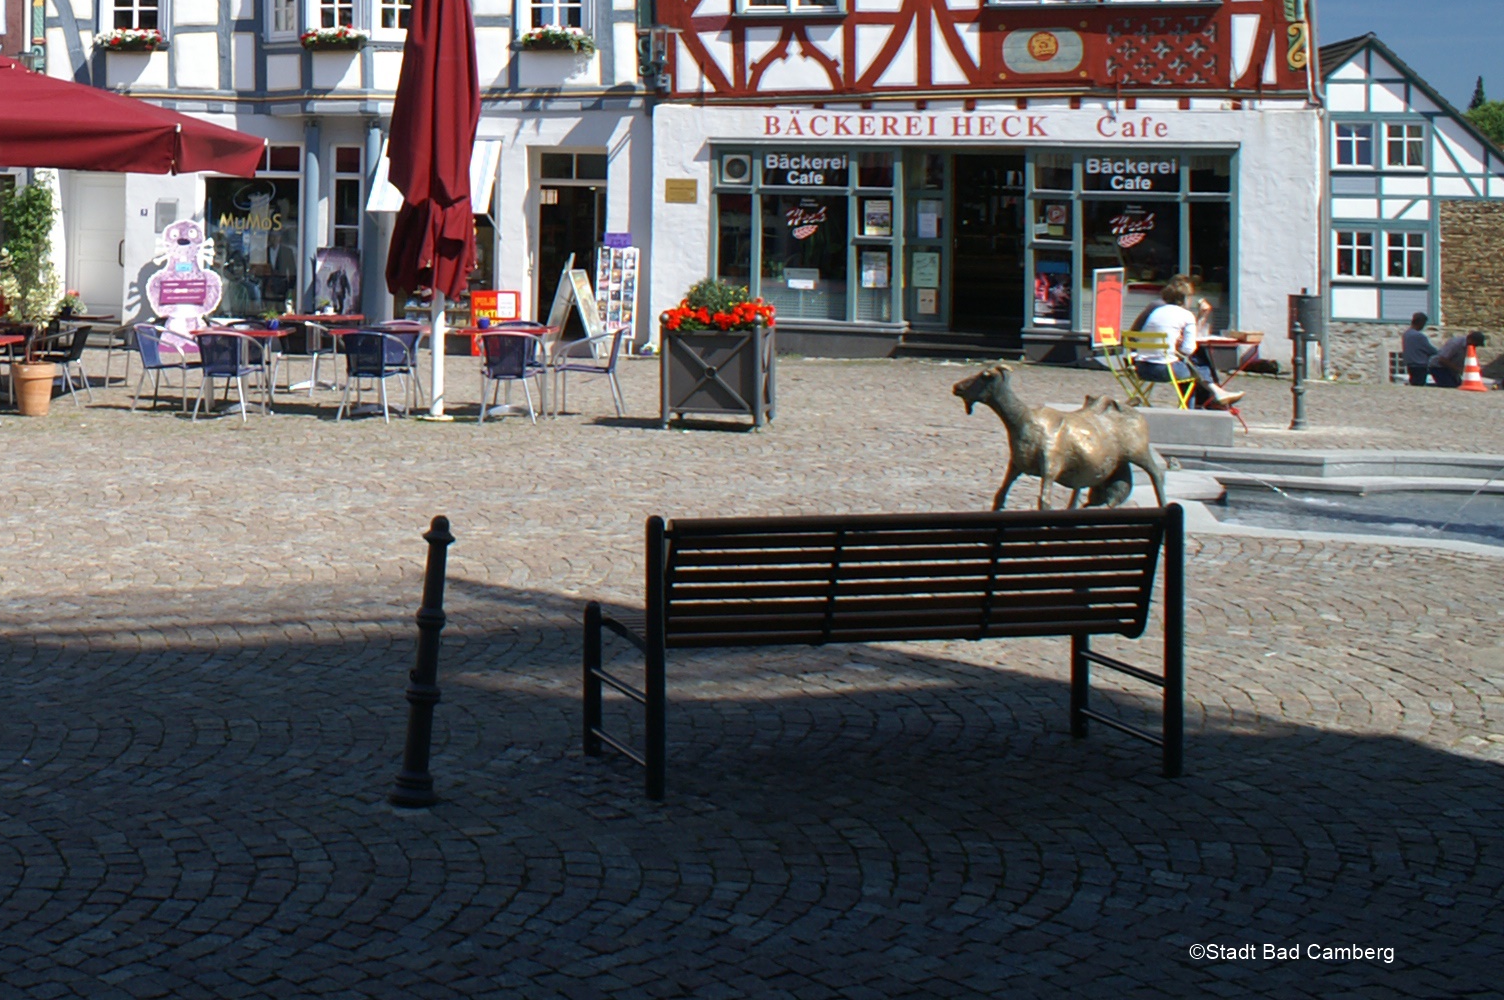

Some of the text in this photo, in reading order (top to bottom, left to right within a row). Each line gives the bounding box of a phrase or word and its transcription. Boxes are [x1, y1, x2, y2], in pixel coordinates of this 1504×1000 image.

[763, 110, 1168, 137] BÄCKEREI HECK Cafe
[765, 154, 846, 170] Bäckerei
[1085, 157, 1176, 174] Bäckerei
[786, 170, 824, 185] Cafe
[1110, 175, 1152, 190] Cafe
